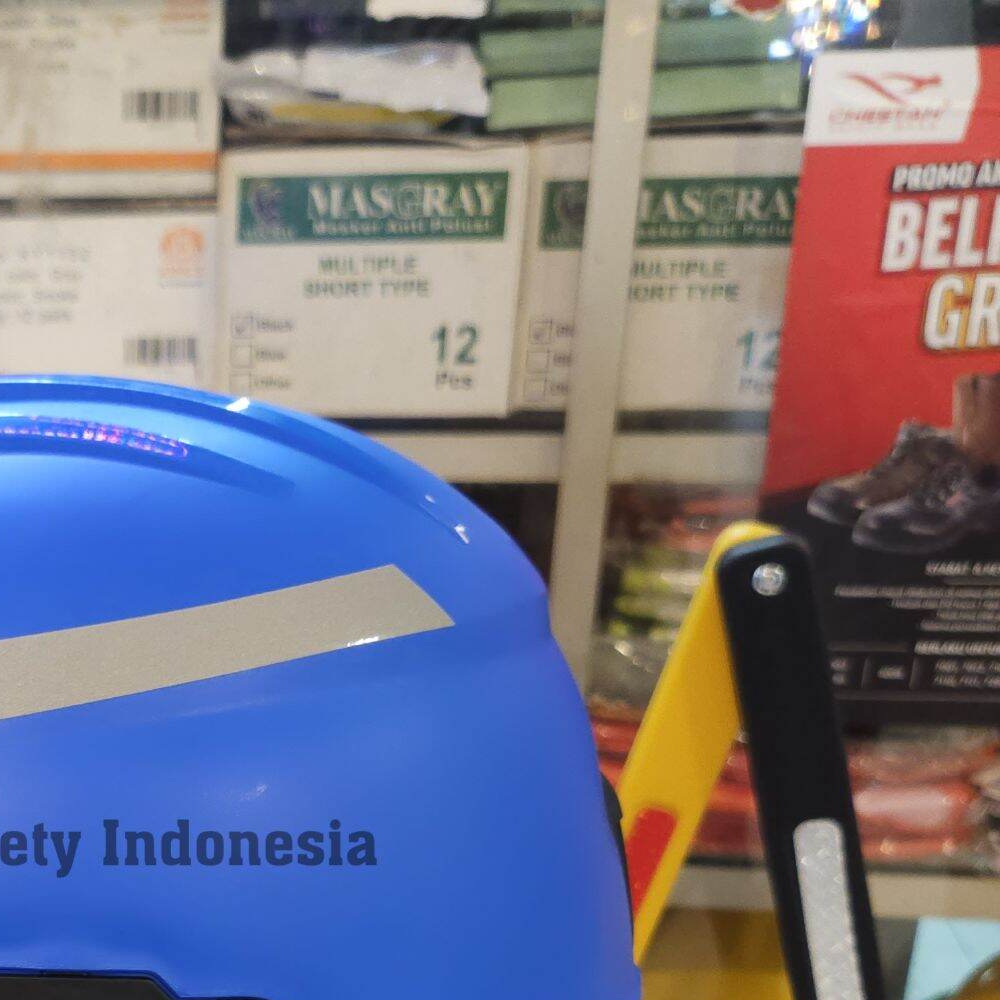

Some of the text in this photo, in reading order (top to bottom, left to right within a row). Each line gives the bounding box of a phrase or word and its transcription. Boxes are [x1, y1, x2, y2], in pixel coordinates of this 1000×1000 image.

[892, 161, 977, 192] PROMO
[318, 256, 420, 275] MULTIPLE
[303, 279, 430, 299] SHORT TYPE
[687, 283, 739, 302] TYPE
[433, 322, 480, 367] 12
[737, 329, 780, 370] 12
[435, 371, 474, 390] Pcs
